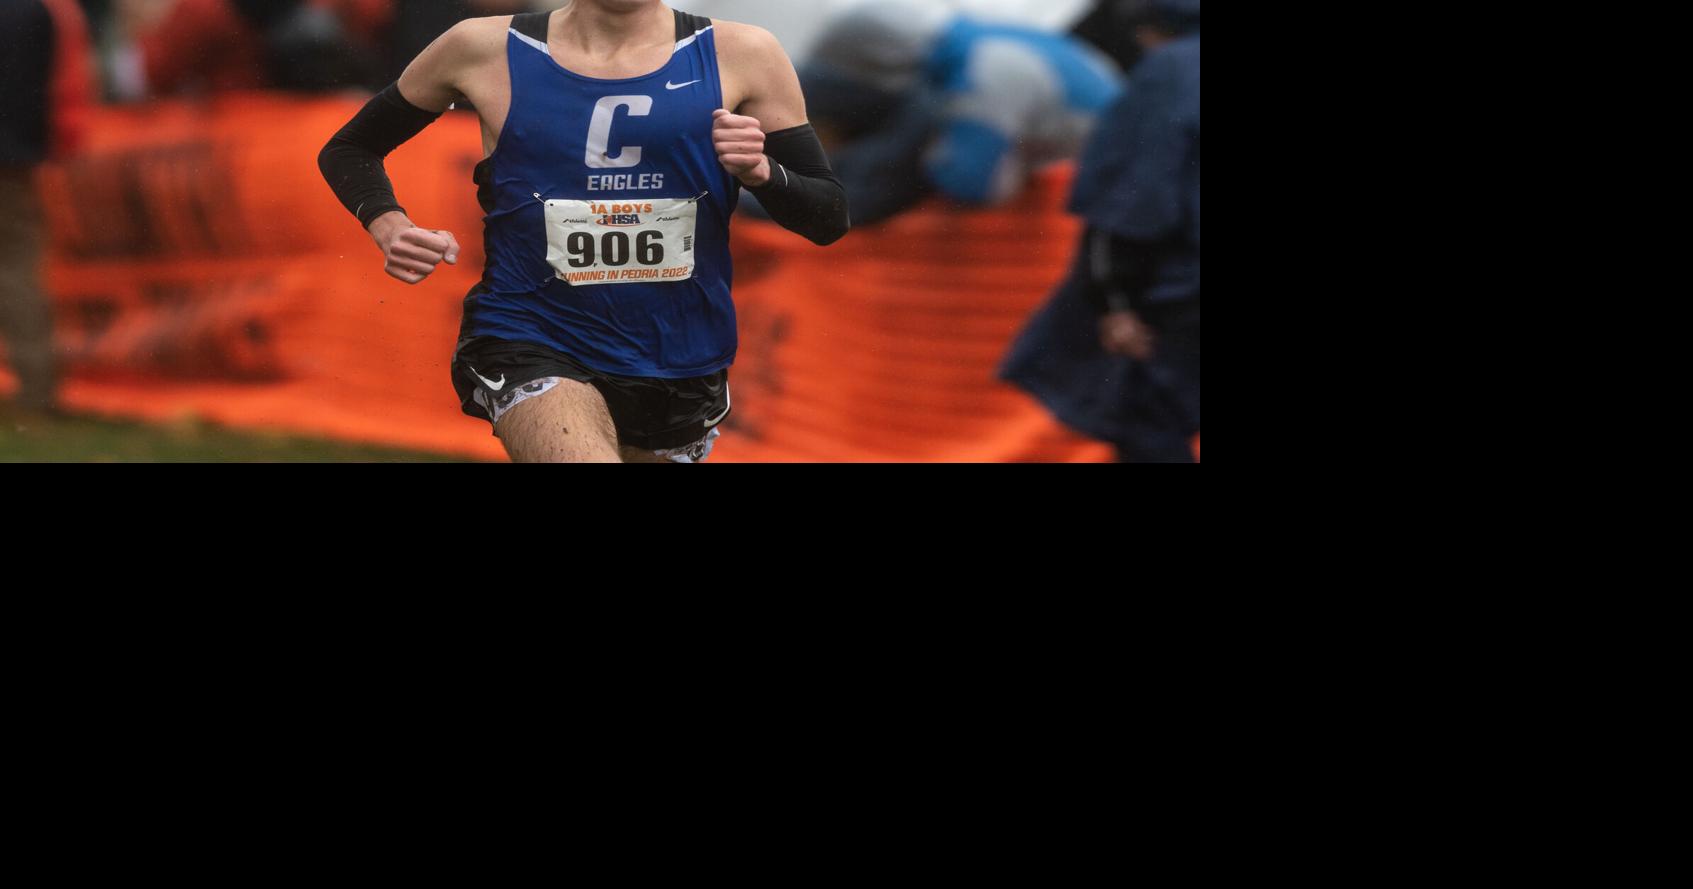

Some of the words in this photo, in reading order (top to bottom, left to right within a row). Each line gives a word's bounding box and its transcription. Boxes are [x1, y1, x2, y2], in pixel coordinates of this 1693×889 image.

[585, 95, 653, 168] C
[587, 174, 664, 190] EAGLES
[591, 203, 608, 214] 1A
[612, 203, 653, 213] BOYS
[567, 230, 664, 267] 906
[563, 270, 605, 282] UNNING
[607, 269, 619, 280] IN
[621, 268, 659, 279] PEORIA
[662, 266, 688, 277] 2022
